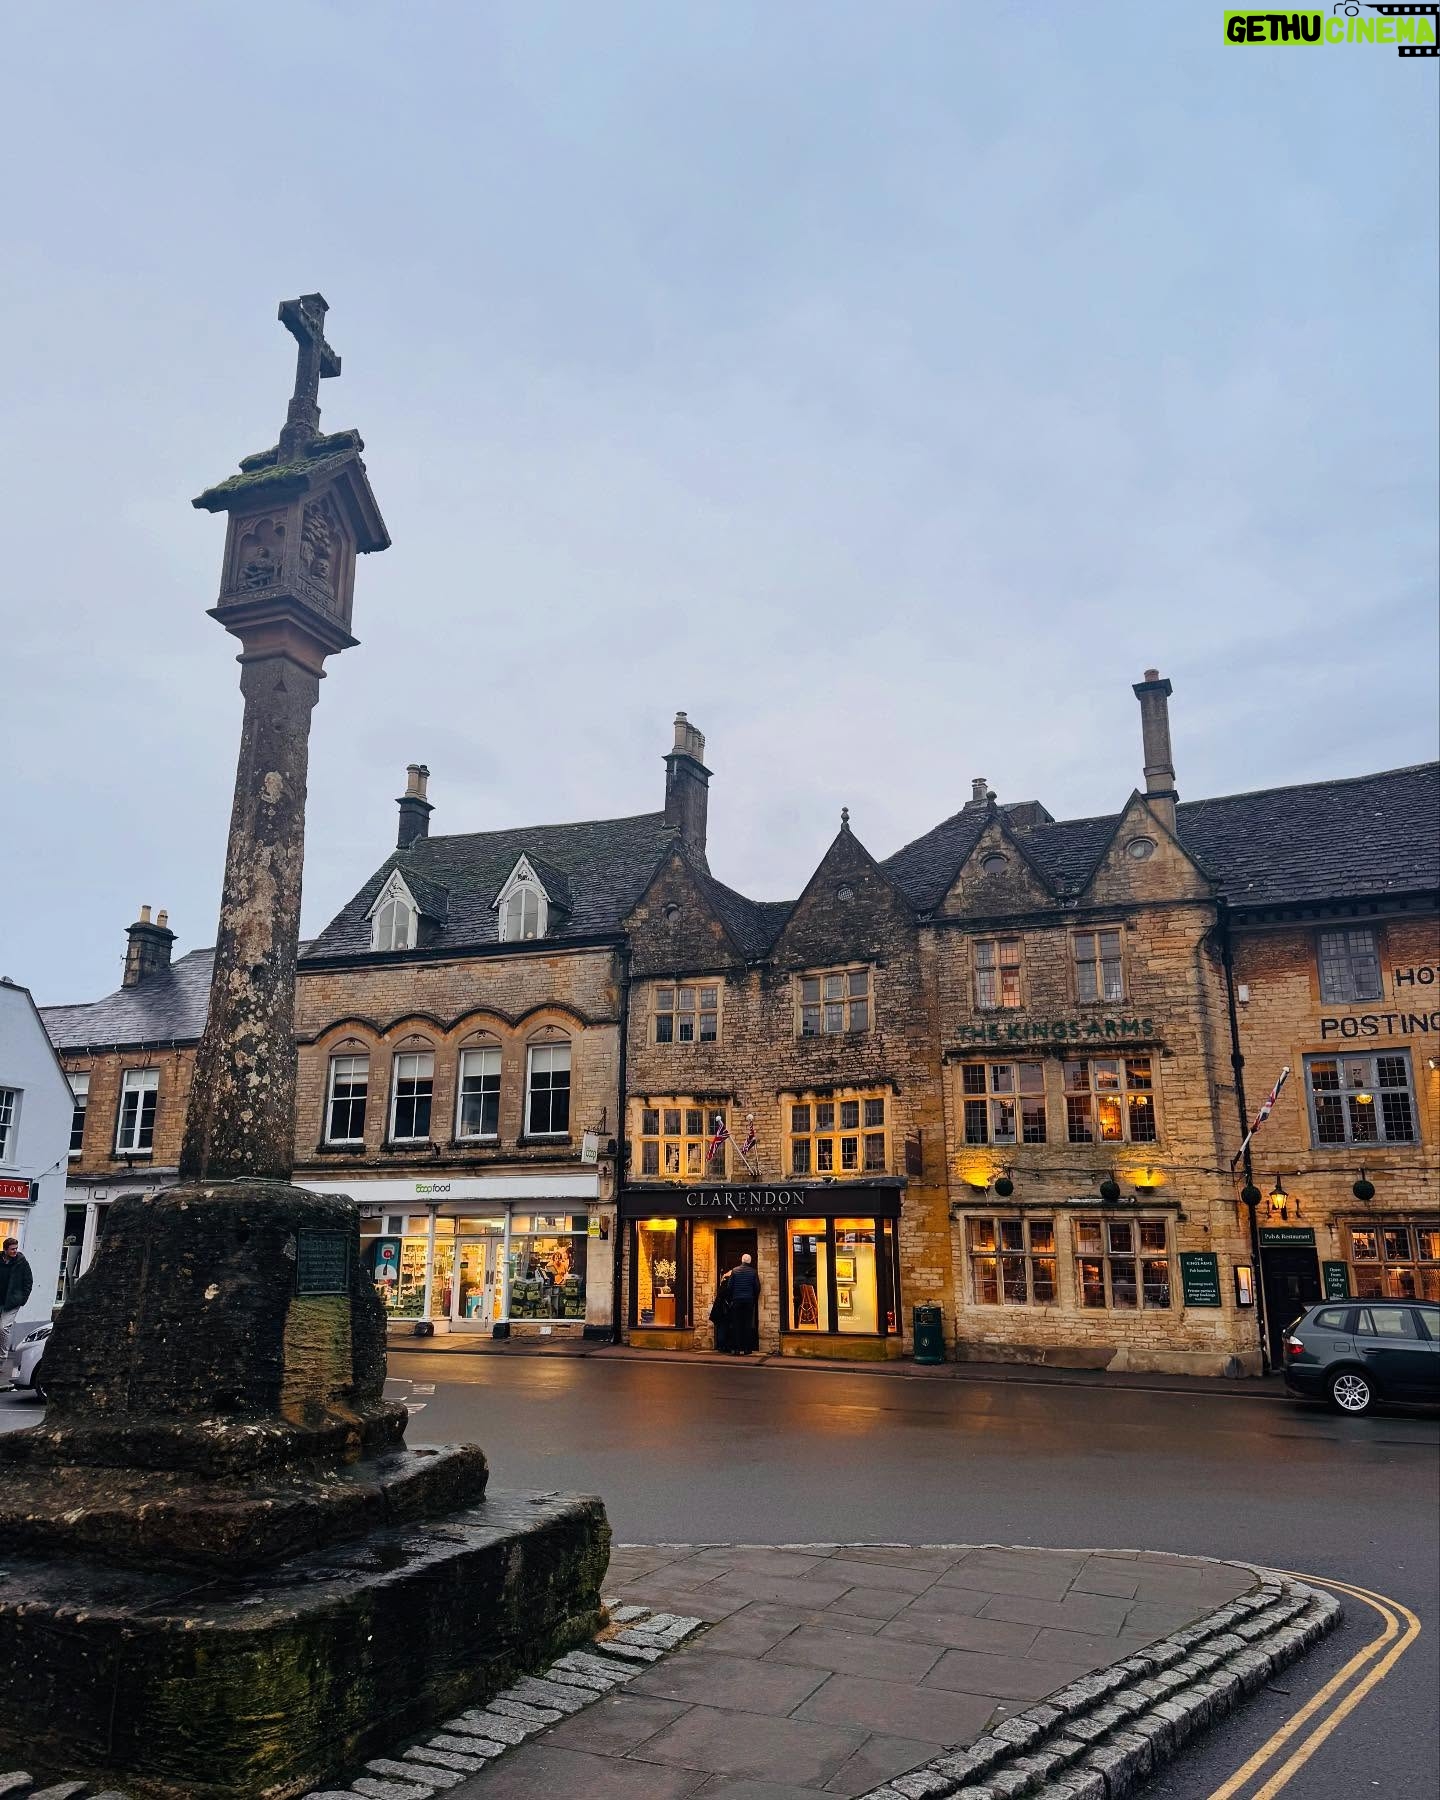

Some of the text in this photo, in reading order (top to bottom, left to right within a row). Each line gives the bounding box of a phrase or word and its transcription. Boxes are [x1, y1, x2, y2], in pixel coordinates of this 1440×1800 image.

[1395, 967, 1440, 987] HO
[957, 1018, 1154, 1041] THE KINGS ARMS
[0, 1184, 24, 1193] TOW
[432, 1183, 451, 1193] food
[686, 1191, 805, 1212] CLARENDON
